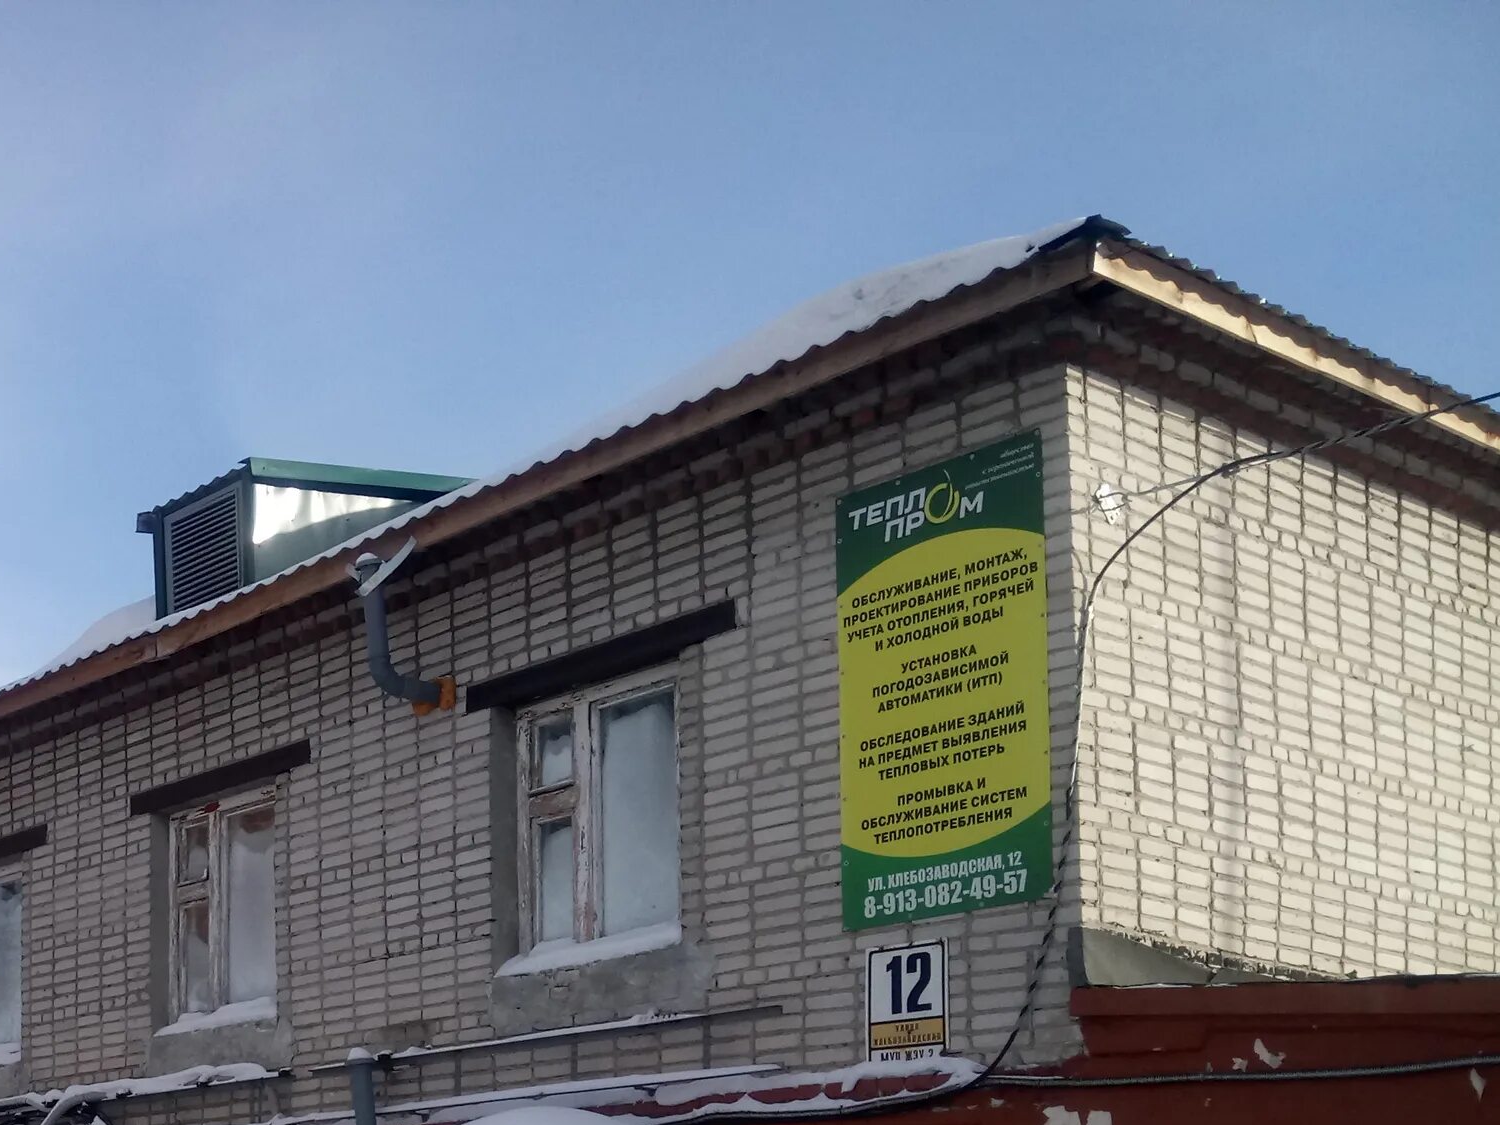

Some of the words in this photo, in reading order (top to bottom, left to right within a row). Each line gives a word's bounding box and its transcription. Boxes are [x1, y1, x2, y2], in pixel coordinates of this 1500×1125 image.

[843, 583, 961, 628] ПРОЕКТИРОВАНИЕ
[964, 561, 1039, 593] ПРИБОРОВ
[851, 567, 961, 609] ОБСЛУЖИВАНИЕ,
[964, 547, 1028, 575] МОНТАЖ,
[846, 623, 885, 643] УЧЕТА
[887, 600, 970, 632] ОТОПЛЕНИЯ,
[972, 578, 1035, 608] ГОРЯЧЕЙ
[875, 640, 884, 652] И
[886, 615, 960, 649] ХОЛОДНОЙ
[963, 606, 1004, 626] ВОДЫ
[872, 651, 1010, 698] ПОГОДОЗАВИСИМОЙ
[901, 644, 978, 674] УСТАНОВКА
[877, 682, 963, 714] АВТОМАТИКИ
[966, 671, 1004, 693] (ИТП)
[859, 756, 875, 770] НА
[878, 741, 939, 764] ПРЕДМЕТ
[942, 720, 1028, 750] ВЫЯВЛЕНИЯ
[860, 717, 965, 752] ОБСЛЕДОВАНИЕ
[968, 700, 1026, 726] ЗДАНИЙ
[878, 756, 950, 781] ТЕПЛОВЫХ
[953, 743, 1006, 764] ПОТЕРЬ
[861, 798, 968, 831] ОБСЛУЖИВАНИЕ
[971, 786, 1028, 807] СИСТЕМ
[897, 780, 974, 807] ПРОМЫВКА
[977, 777, 987, 789] И
[874, 807, 1013, 845] ТЕПЛОПОТРЕБЛЕНИЯ
[864, 868, 1028, 919] 8-913-082-49-57
[867, 876, 887, 893] УЛ.
[887, 854, 1005, 887] ХЛЕБОЗАВОДСКАЯ,
[1007, 850, 1023, 867] 12
[885, 951, 933, 1015] 12
